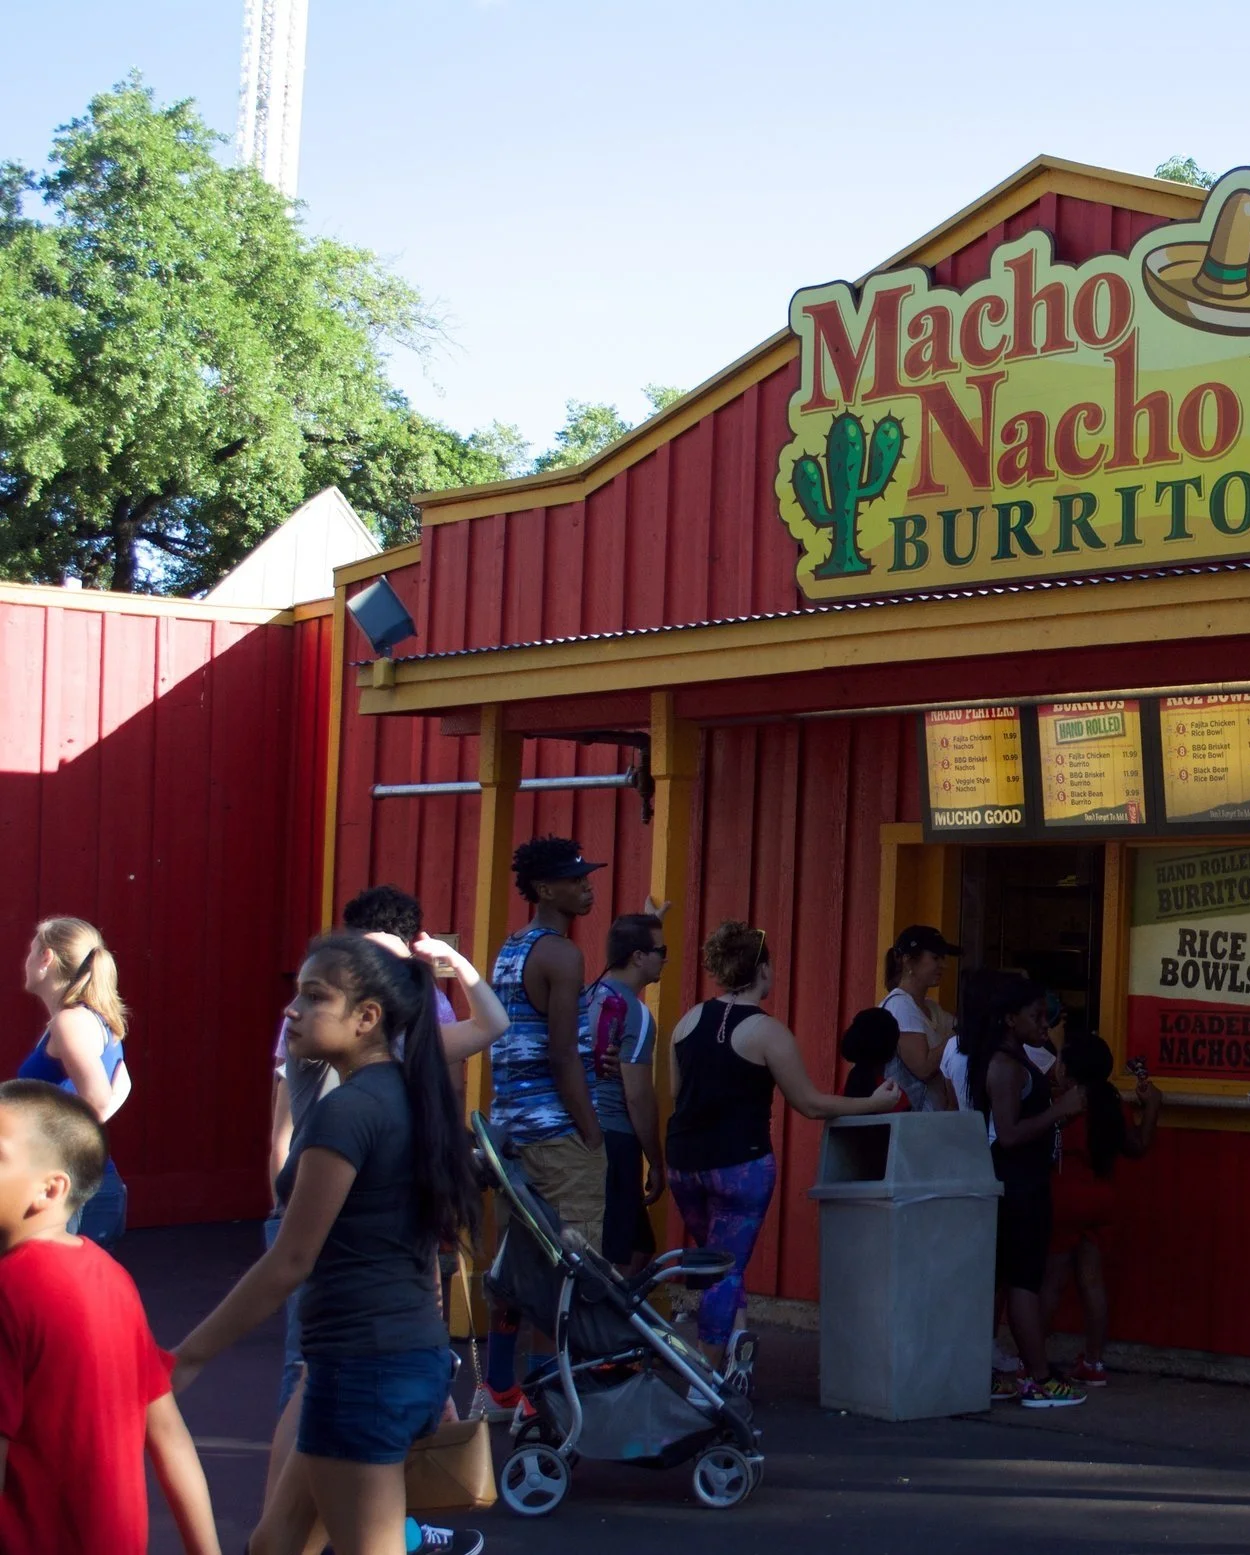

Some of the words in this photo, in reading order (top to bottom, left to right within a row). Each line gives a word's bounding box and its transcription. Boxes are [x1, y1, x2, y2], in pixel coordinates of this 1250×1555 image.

[801, 248, 1134, 412] Macho
[902, 328, 1243, 499] Nacho
[1059, 721, 1084, 739] HAND
[1086, 716, 1120, 736] ROLLED
[1207, 728, 1223, 736] Bowl
[953, 735, 968, 743] Fajita
[1209, 774, 1225, 782] Bowl
[934, 810, 981, 826] MUCHO
[984, 809, 1022, 824] GOOD
[1156, 862, 1196, 883] HAND
[1177, 928, 1247, 961] RICE
